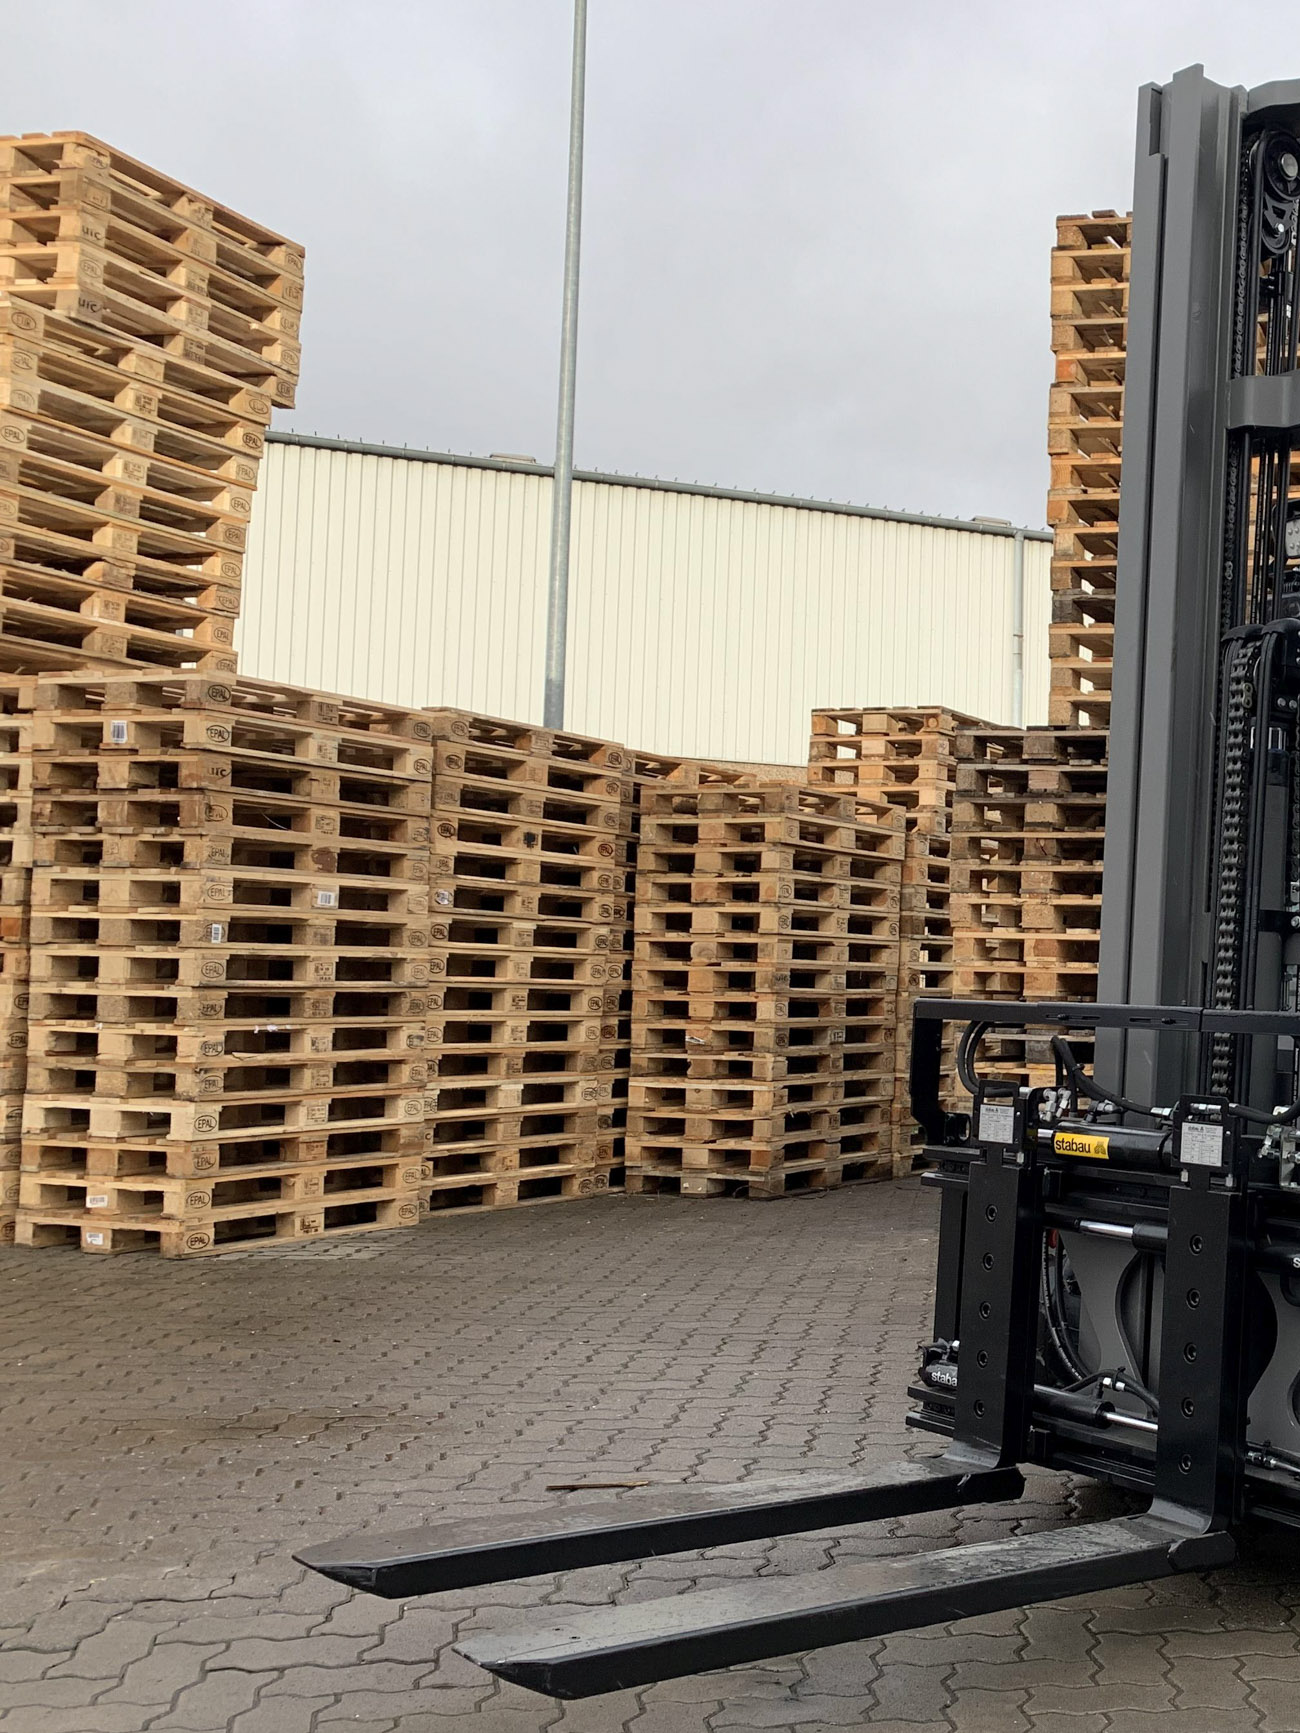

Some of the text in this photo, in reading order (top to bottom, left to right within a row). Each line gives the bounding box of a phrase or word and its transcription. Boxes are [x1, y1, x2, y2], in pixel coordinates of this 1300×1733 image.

[3, 427, 22, 441] EPAL
[1055, 1137, 1091, 1154] stabau
[931, 1371, 958, 1387] staba
